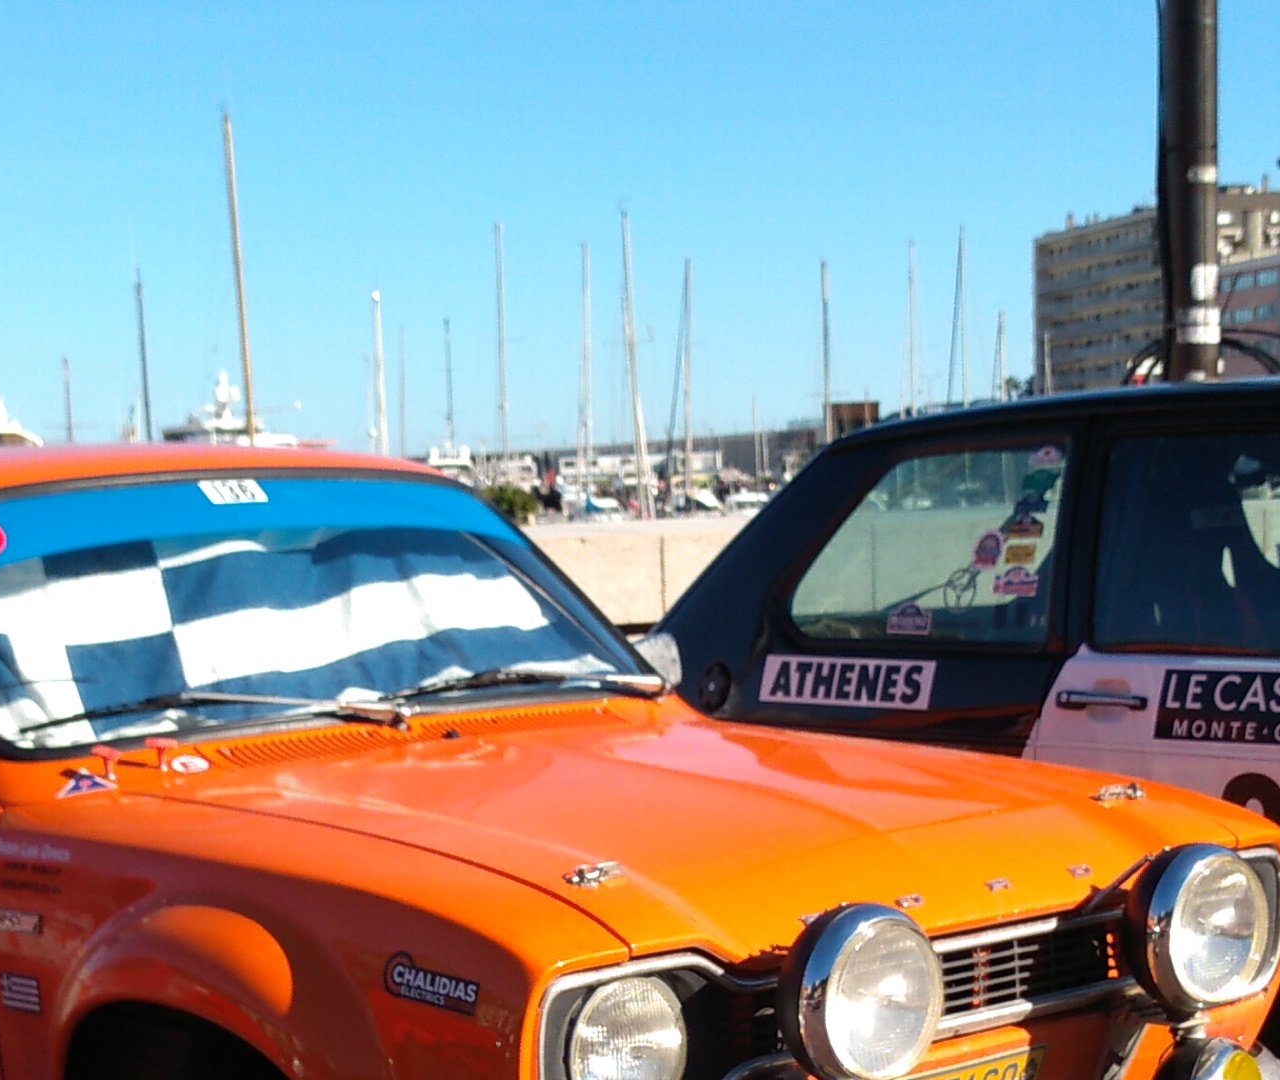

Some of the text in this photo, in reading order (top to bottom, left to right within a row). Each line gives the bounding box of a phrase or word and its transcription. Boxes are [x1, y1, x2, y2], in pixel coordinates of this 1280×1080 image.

[769, 660, 923, 703] ATHENES
[1165, 673, 1208, 710] LE
[393, 964, 477, 1003] CHALIDIAS
[400, 985, 446, 1006] ELECTRICS
